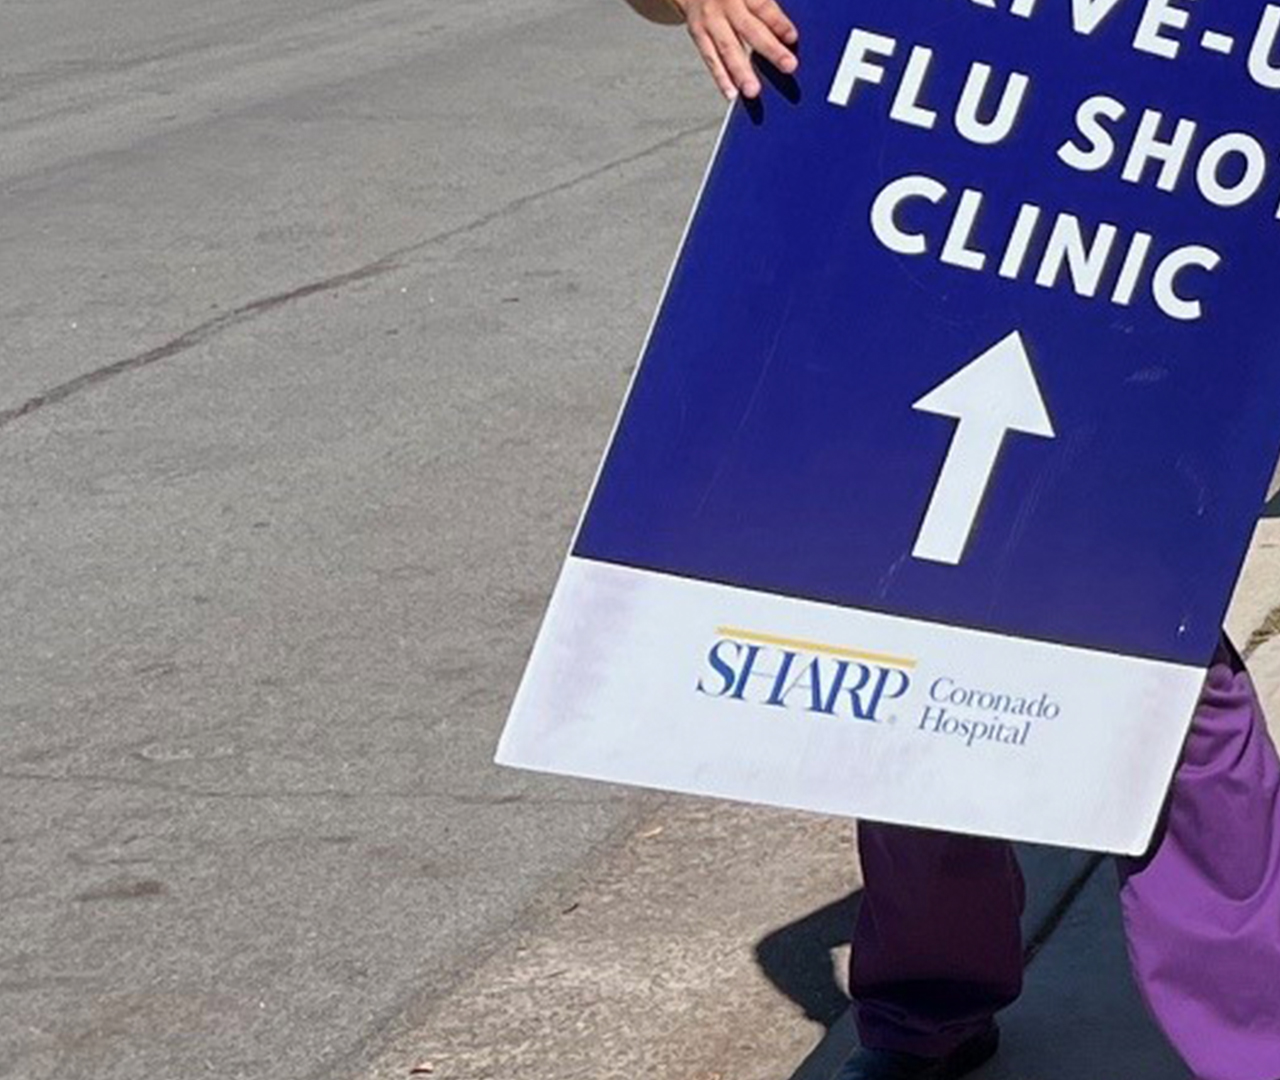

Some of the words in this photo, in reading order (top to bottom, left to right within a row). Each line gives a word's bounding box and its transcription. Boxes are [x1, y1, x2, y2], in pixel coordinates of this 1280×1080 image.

[826, 27, 1030, 144] FLU
[869, 174, 1222, 321] CLINIC
[696, 637, 910, 722] SHARP
[929, 676, 1061, 720] Coronado
[917, 706, 1031, 748] Hospital
